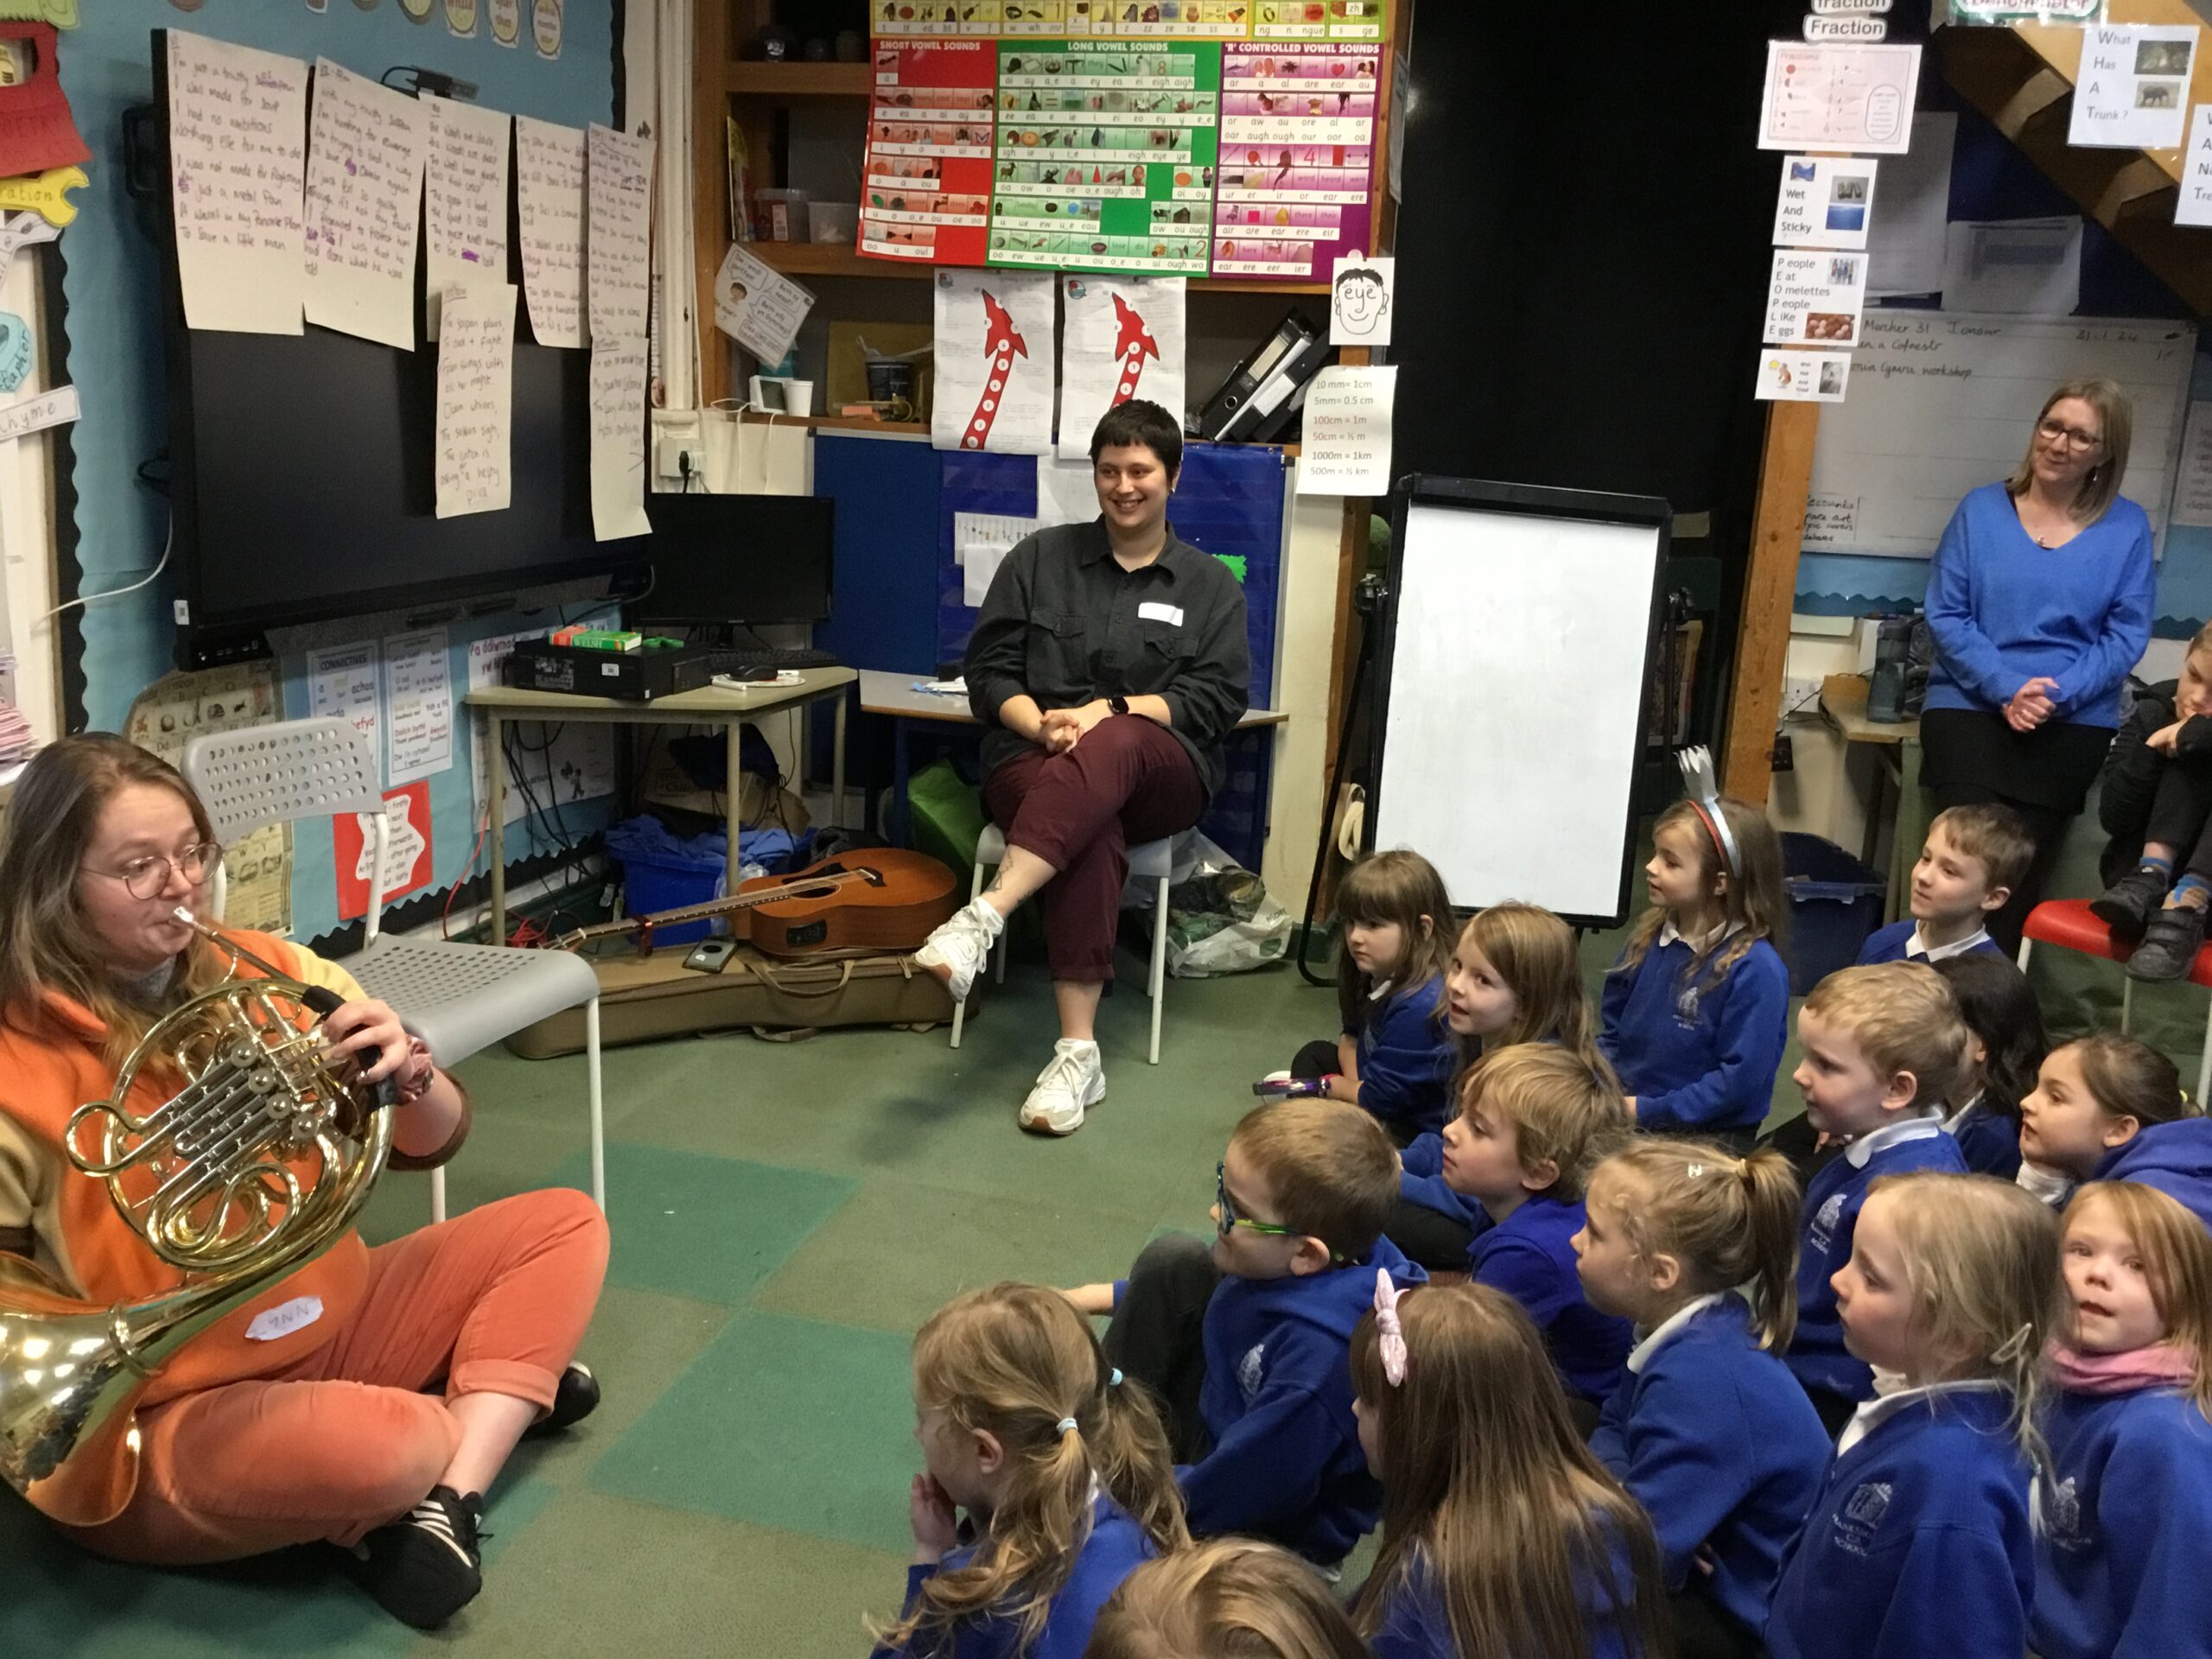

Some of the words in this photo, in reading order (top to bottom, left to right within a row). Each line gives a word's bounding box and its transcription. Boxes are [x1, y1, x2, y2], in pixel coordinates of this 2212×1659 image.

[1349, 3, 1359, 12] zh
[1260, 26, 1270, 36] ng
[1811, 20, 1883, 35] Fraction
[2098, 31, 2131, 45] What
[880, 41, 909, 50] SHORT
[912, 41, 941, 50] VOWEL
[944, 41, 981, 51] SOUNDS
[1067, 42, 1093, 51] LONG
[1096, 42, 1128, 51] VOWEL
[1130, 43, 1168, 52] SOUNDS
[1239, 44, 1301, 53] CONTROLLED
[1303, 44, 1337, 54] VOWEL
[1339, 45, 1380, 54] SOUNDS
[2094, 57, 2115, 70] Has
[2089, 81, 2099, 94] A
[2087, 107, 2118, 119] Trunk
[1247, 131, 1268, 143] augh
[1273, 131, 1294, 143] ough
[0, 185, 53, 202] ration
[1785, 189, 1805, 200] Wet
[2194, 188, 2212, 201] Tre
[1783, 206, 1803, 216] And
[1189, 225, 1208, 236] ough
[1781, 221, 1812, 234] Sticky
[1788, 259, 1815, 269] eople
[1777, 271, 1782, 280] E
[1785, 272, 1796, 281] at
[1774, 285, 1782, 294] O
[1785, 286, 1830, 296] melettes
[1344, 286, 1376, 314] eye
[1772, 298, 1779, 307] P
[1782, 299, 1810, 309] eople
[1778, 327, 1795, 337] ggs
[1916, 323, 1929, 334] 31
[1922, 365, 1973, 382] workshop
[1316, 380, 1325, 389] 10
[1353, 380, 1372, 389] 1cm
[1313, 416, 1343, 424] 100cm
[1353, 416, 1367, 424] 1m
[1313, 432, 1337, 441] 50cm
[1312, 451, 1342, 460] 1000m
[1353, 451, 1372, 460] 1km
[1310, 467, 1335, 475] 500m
[1355, 467, 1369, 475] km
[1833, 513, 1852, 524] art
[574, 639, 602, 649] WELSH
[320, 653, 367, 671] CONNECTIVES
[351, 681, 374, 695] achos
[389, 833, 413, 848] fterwards
